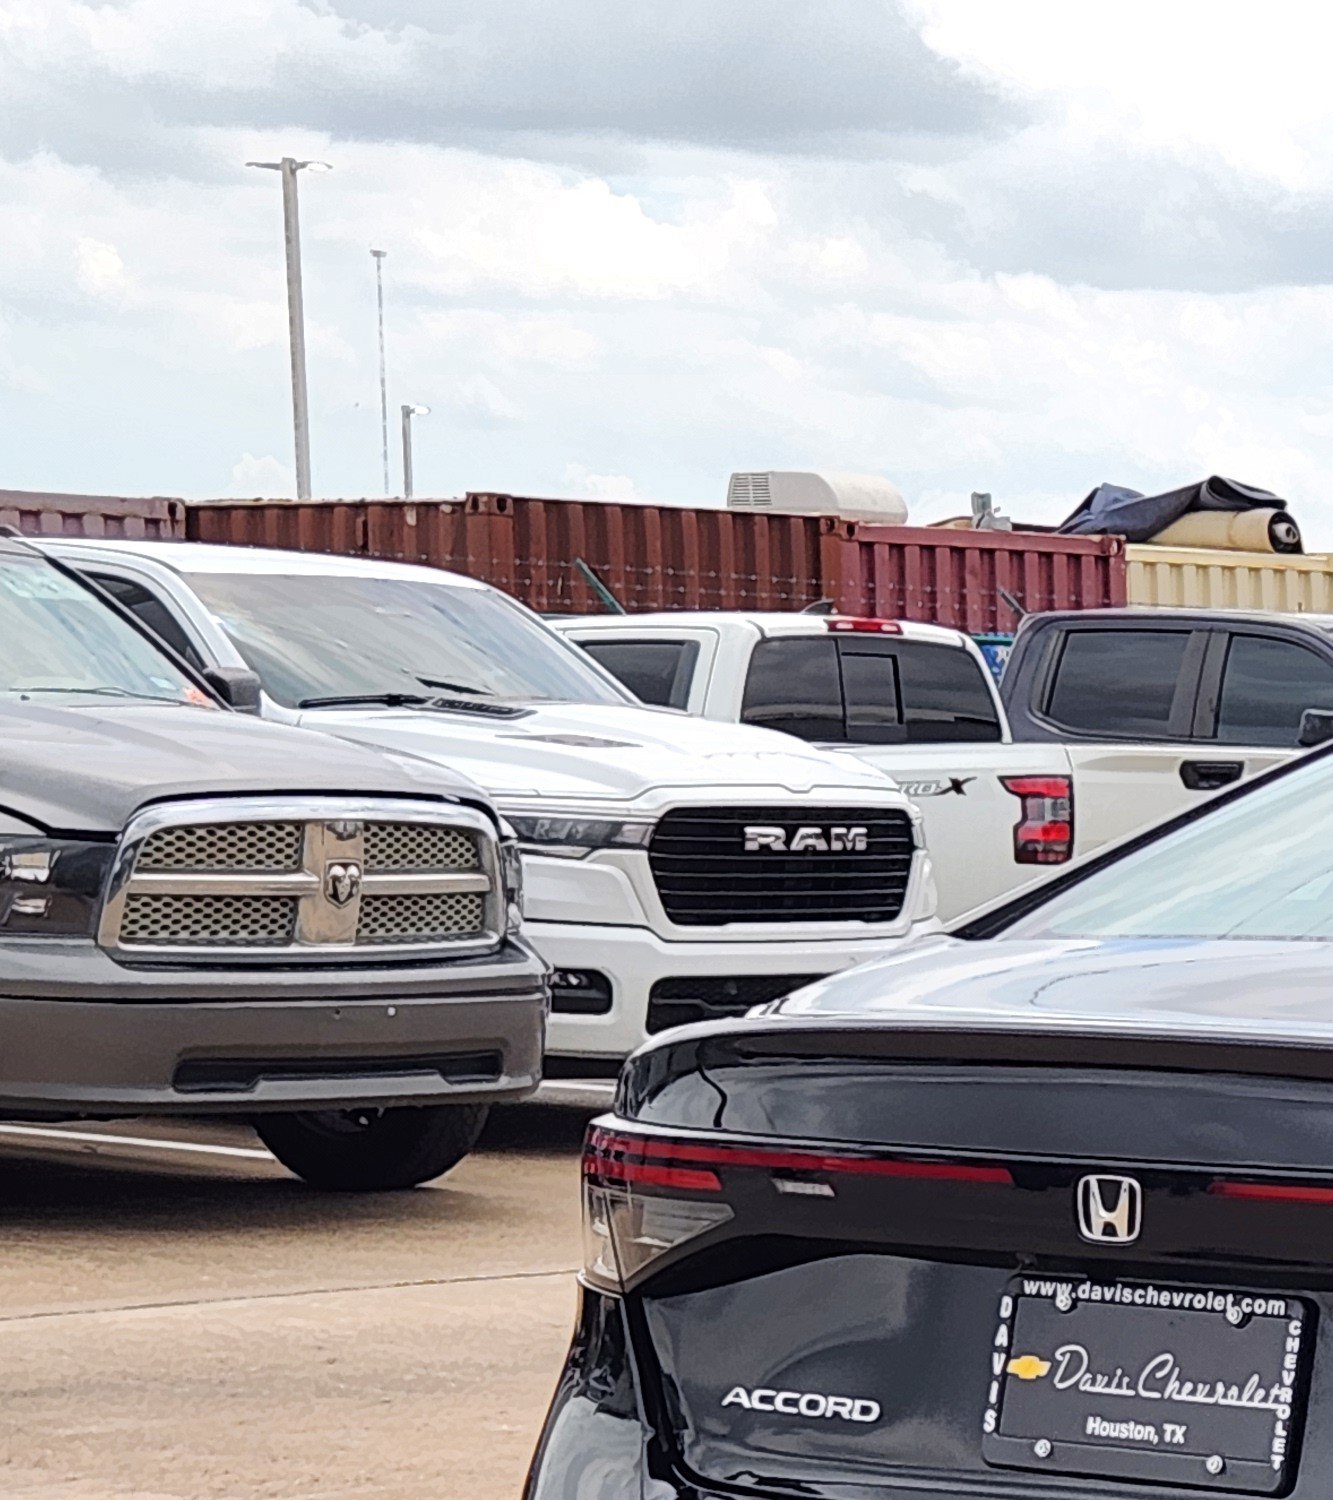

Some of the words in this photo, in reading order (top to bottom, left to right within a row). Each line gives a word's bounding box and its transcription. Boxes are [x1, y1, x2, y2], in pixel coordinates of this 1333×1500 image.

[744, 826, 868, 851] RAM
[1023, 1280, 1287, 1316] www.davischevrolet.com
[983, 1295, 1013, 1434] DAVIS
[1054, 1344, 1136, 1397] Davis
[1138, 1353, 1283, 1410] Chevrolet
[721, 1386, 881, 1422] ACCORD
[1270, 1319, 1302, 1472] CHEVROLET
[1086, 1416, 1159, 1445] Houston,
[1163, 1423, 1187, 1444] TX
